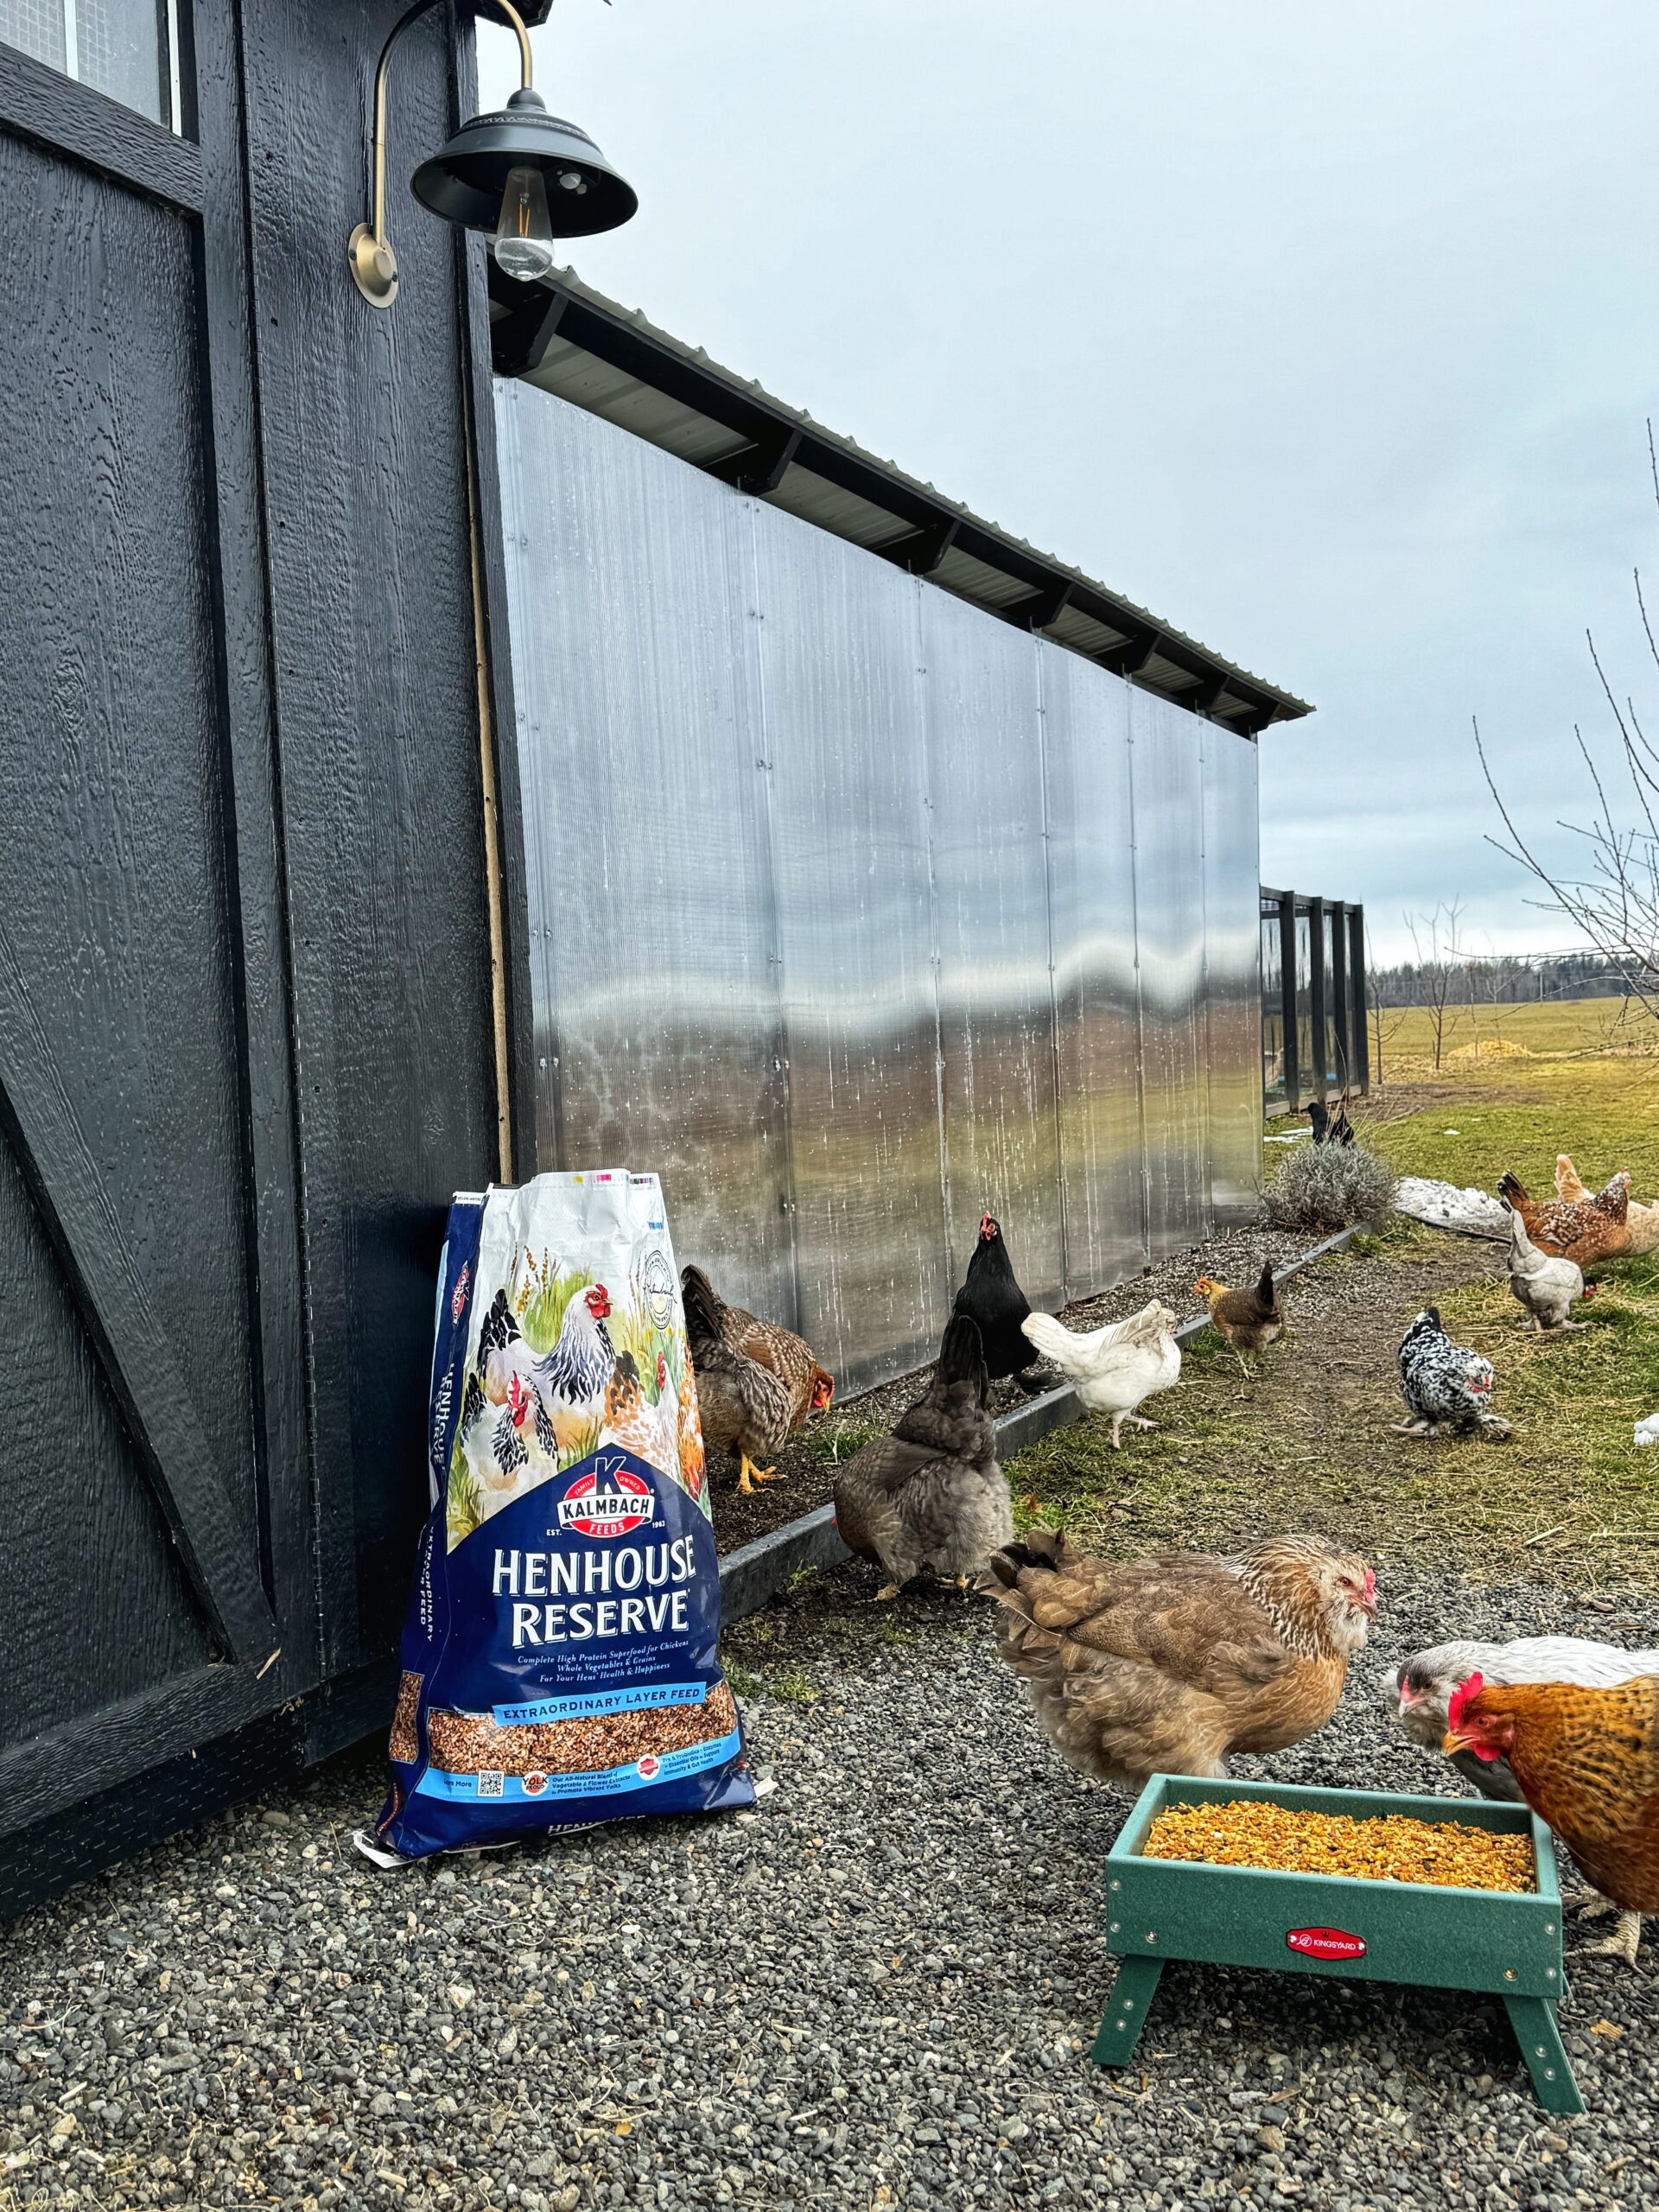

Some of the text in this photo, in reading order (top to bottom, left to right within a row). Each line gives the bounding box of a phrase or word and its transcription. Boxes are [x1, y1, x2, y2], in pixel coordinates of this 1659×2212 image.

[574, 1476, 641, 1496] FAMILY OWNED
[595, 1456, 626, 1496] K
[563, 1498, 650, 1520] KALMBACH
[588, 1522, 625, 1535] FEEDS
[492, 1534, 696, 1597] HENHOUSE
[512, 1590, 690, 1649] RESERVE
[518, 1640, 690, 1666] Complete High Protein Superfood for Chickens
[539, 1662, 671, 1683] For Your Hens' Health & Happiness
[557, 1655, 656, 1673] Whole Vegetables & Grains
[503, 1688, 700, 1719] EXTRAORDINARY LAYER FEED
[523, 1777, 549, 1786] YOLK
[608, 1775, 631, 1784] Extracts
[1313, 1939, 1357, 1950] KINGSYARD
